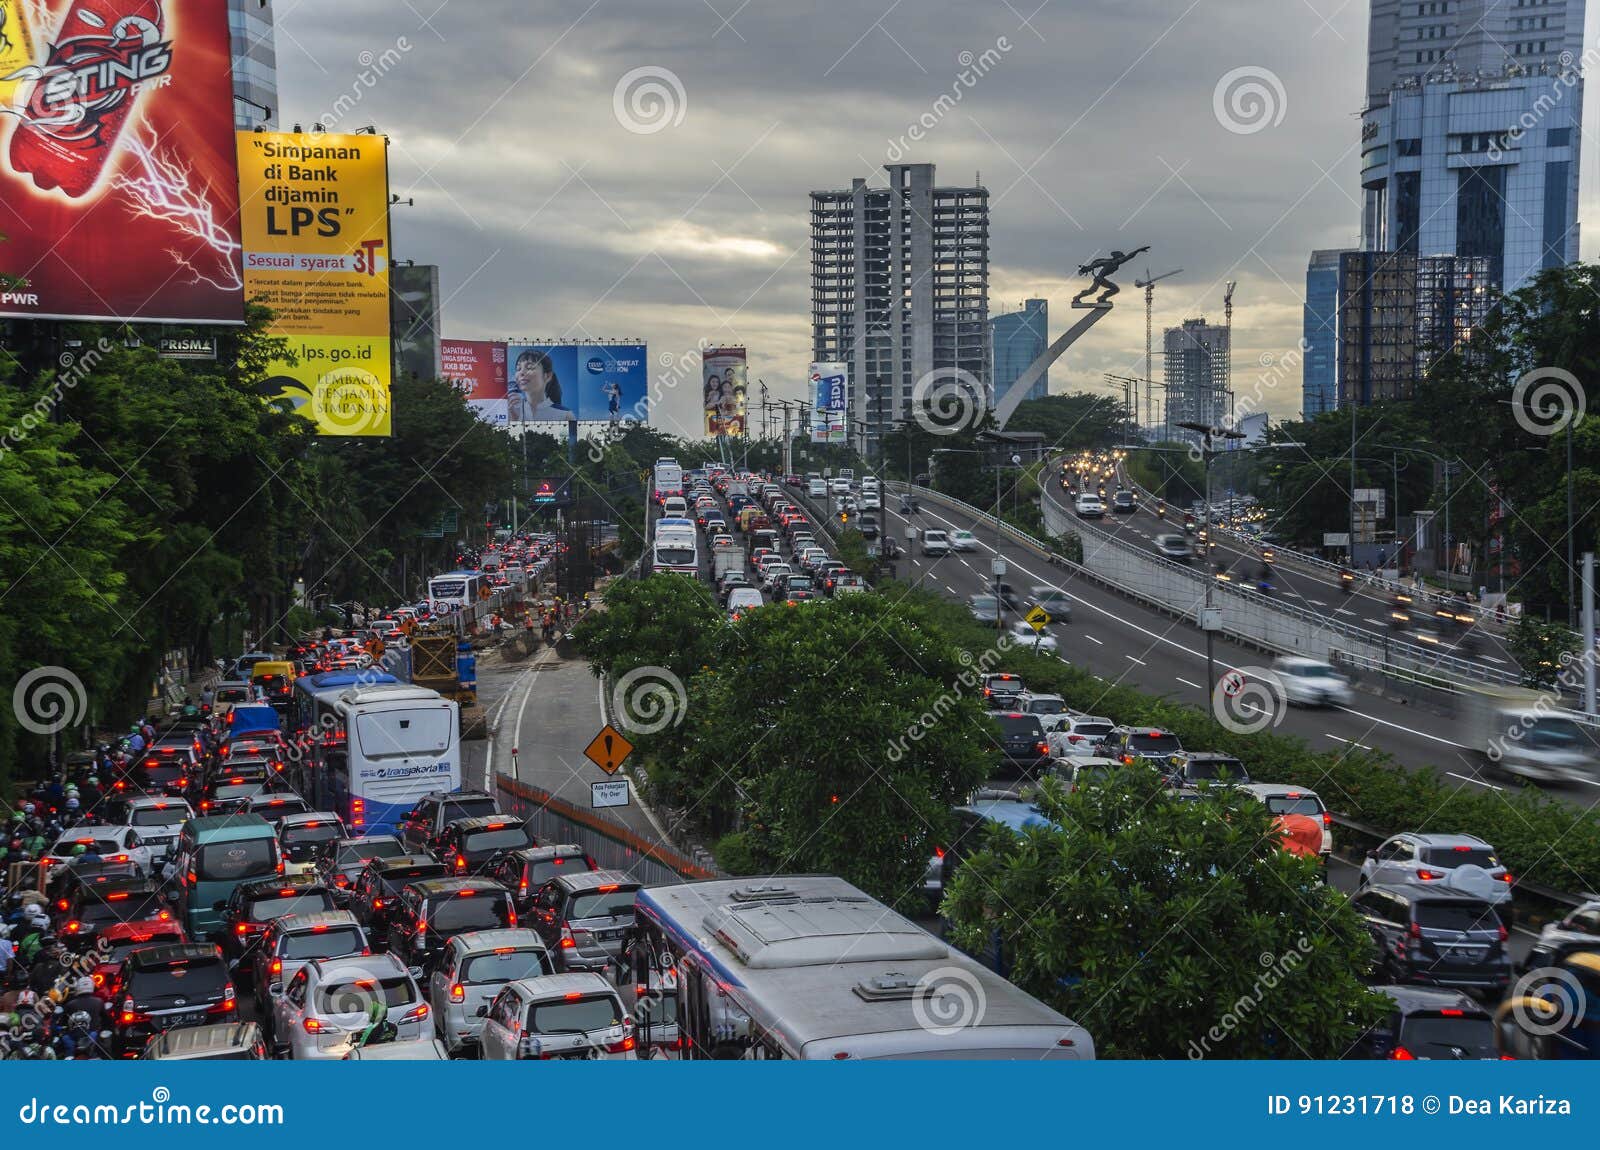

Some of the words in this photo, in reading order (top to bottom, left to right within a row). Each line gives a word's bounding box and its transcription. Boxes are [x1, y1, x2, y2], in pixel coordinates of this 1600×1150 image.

[45, 47, 172, 104] STING
[264, 164, 281, 180] di
[288, 165, 338, 182] Bank
[264, 186, 338, 205] dijamin
[248, 254, 295, 268] Sesuai
[301, 257, 345, 271] syarat
[353, 239, 384, 277] 3T
[1, 292, 39, 306] PWR
[317, 373, 381, 386] LEMBAGA
[317, 387, 388, 400] PENJAMIN
[317, 401, 388, 414] SIMPANAN
